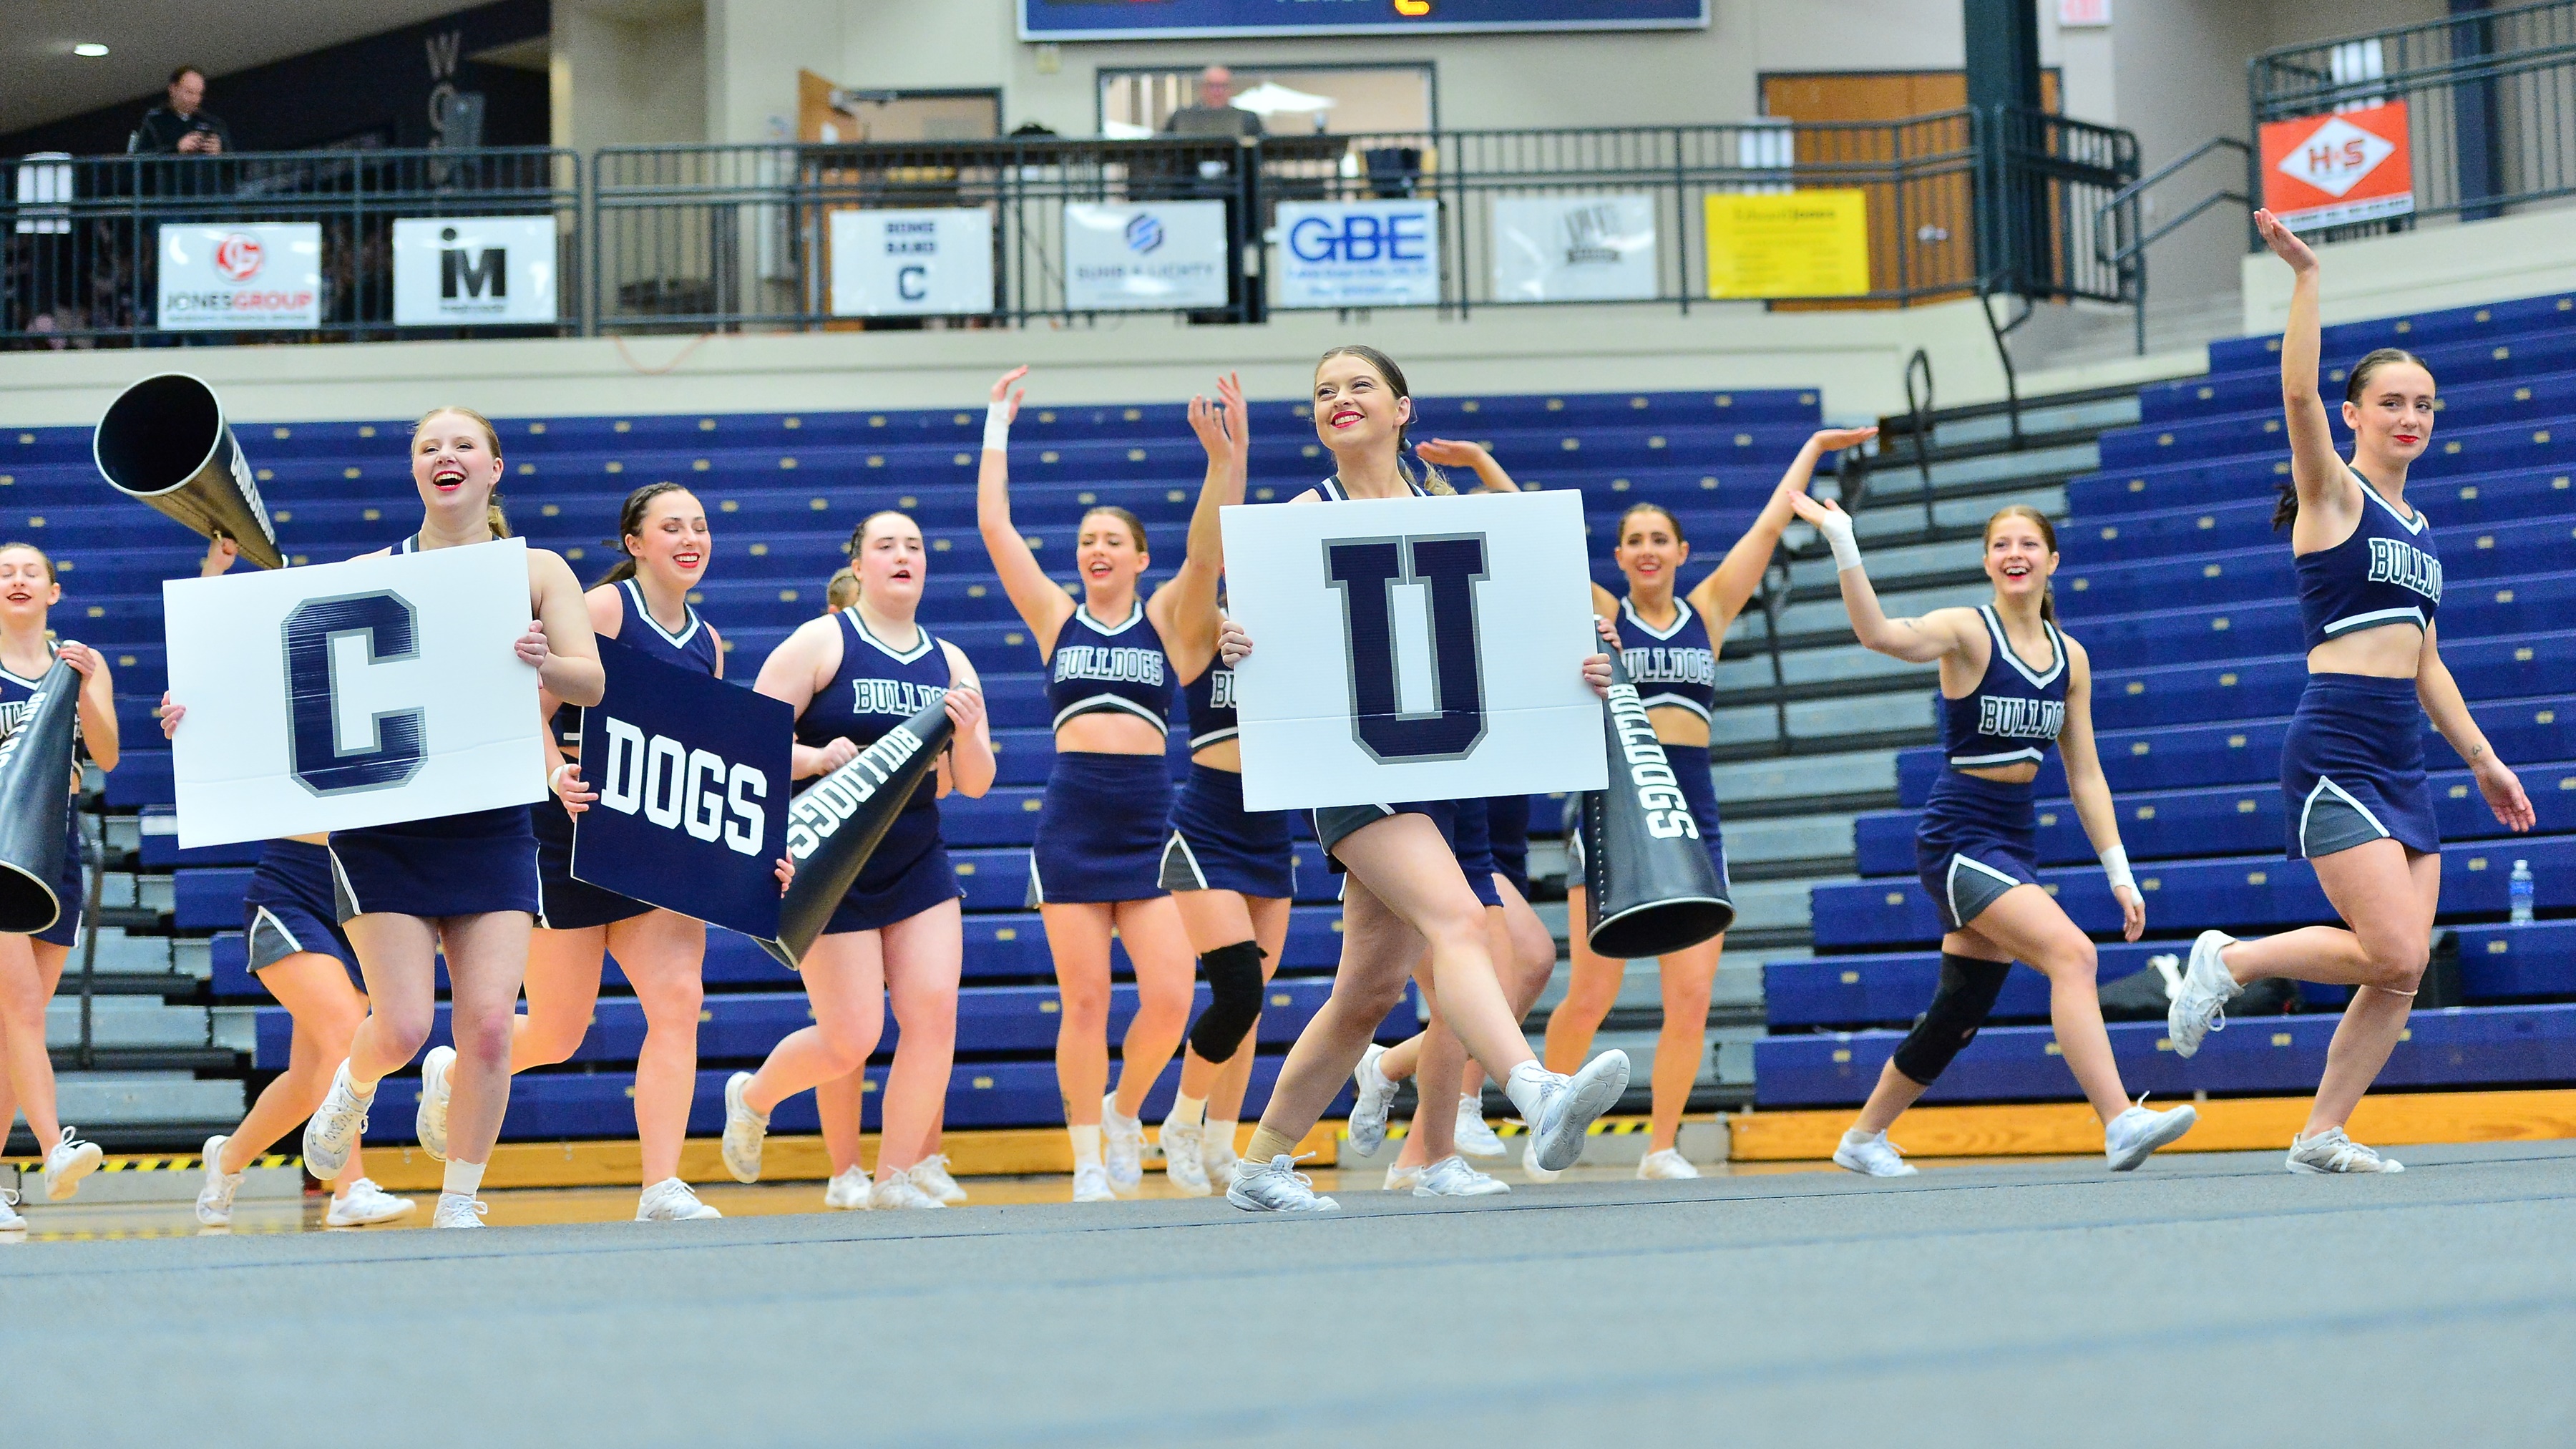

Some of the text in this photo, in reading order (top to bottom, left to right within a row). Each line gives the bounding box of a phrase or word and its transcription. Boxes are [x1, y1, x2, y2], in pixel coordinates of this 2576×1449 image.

[899, 266, 925, 301] C
[1290, 215, 1425, 262] GBE
[280, 589, 429, 798] C
[1054, 645, 1164, 687] BULLDOGS
[1321, 532, 1491, 765] U
[601, 716, 767, 857] DOGS
[786, 725, 923, 859] BULLDOGS
[1607, 683, 1699, 840] BULLDOGS
